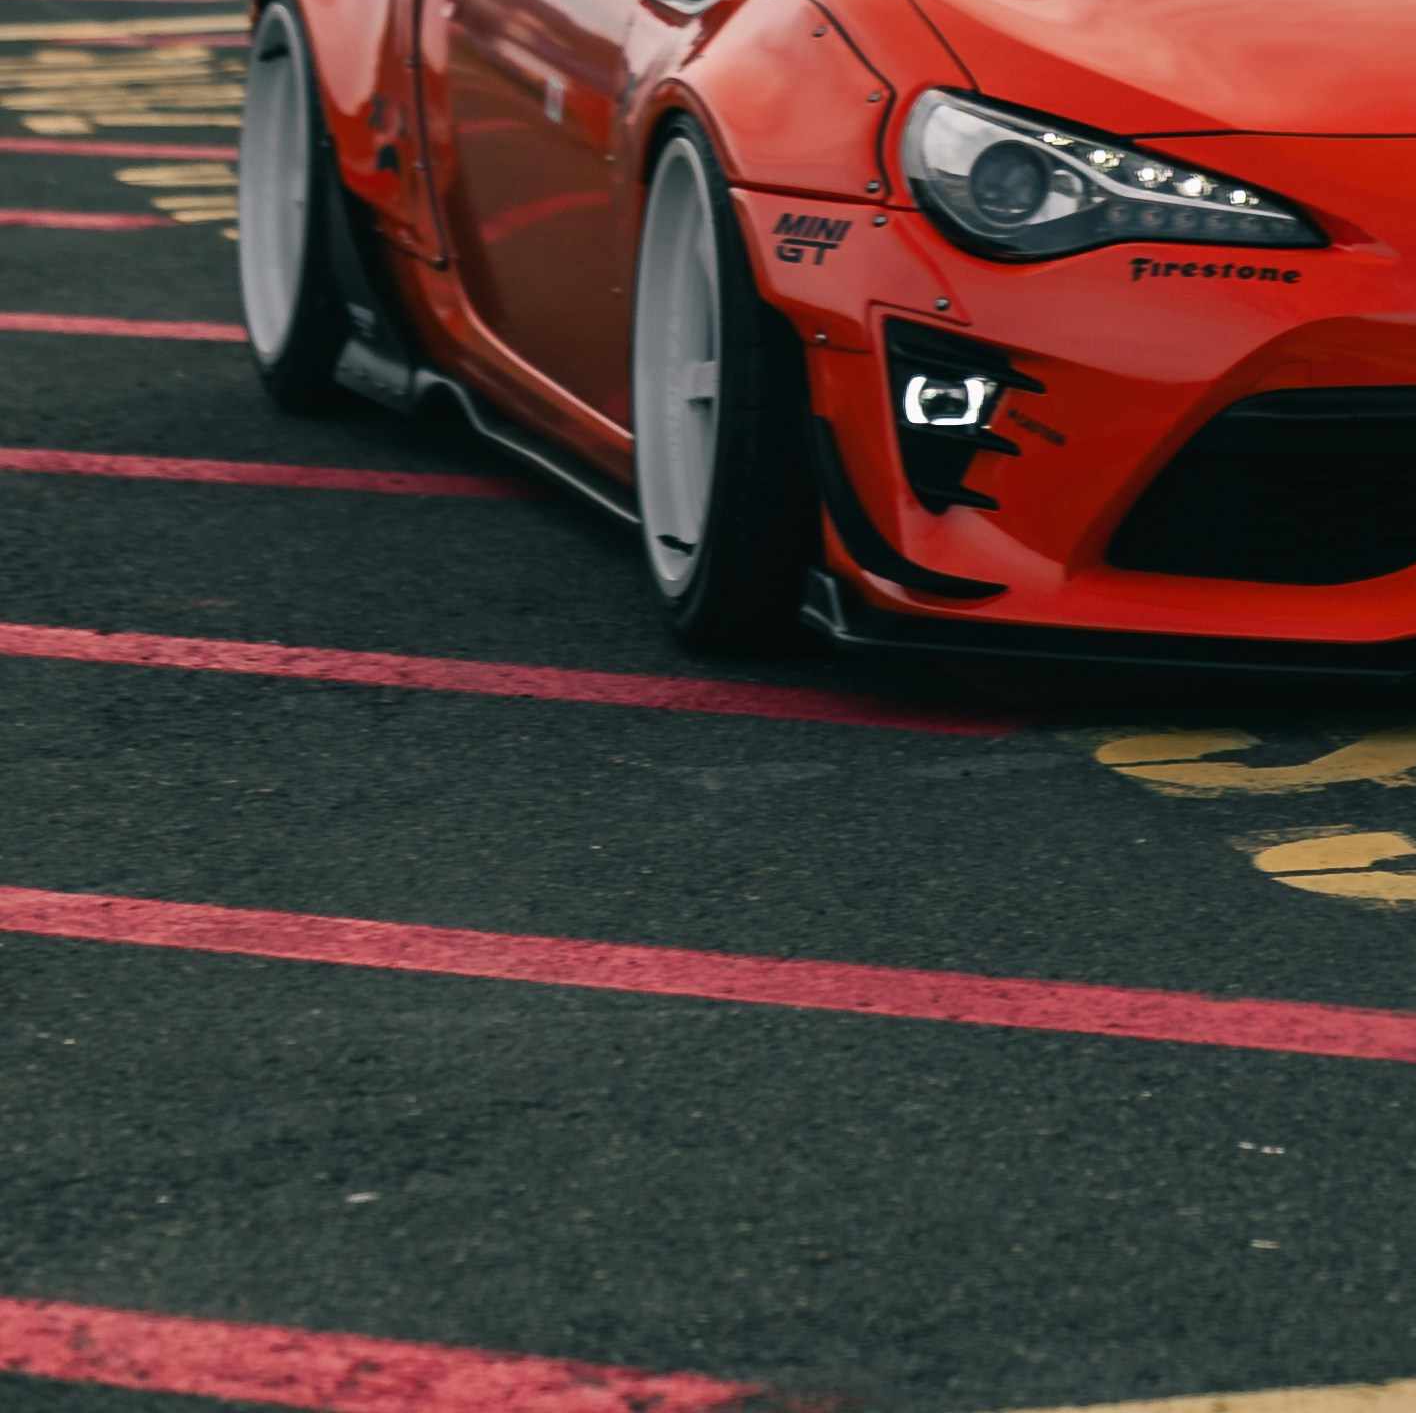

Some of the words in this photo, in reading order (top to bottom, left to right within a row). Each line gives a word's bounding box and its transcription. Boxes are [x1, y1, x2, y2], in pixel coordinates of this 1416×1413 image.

[772, 212, 854, 242] MINI
[775, 238, 840, 266] GT
[1129, 257, 1302, 284] Firestone
